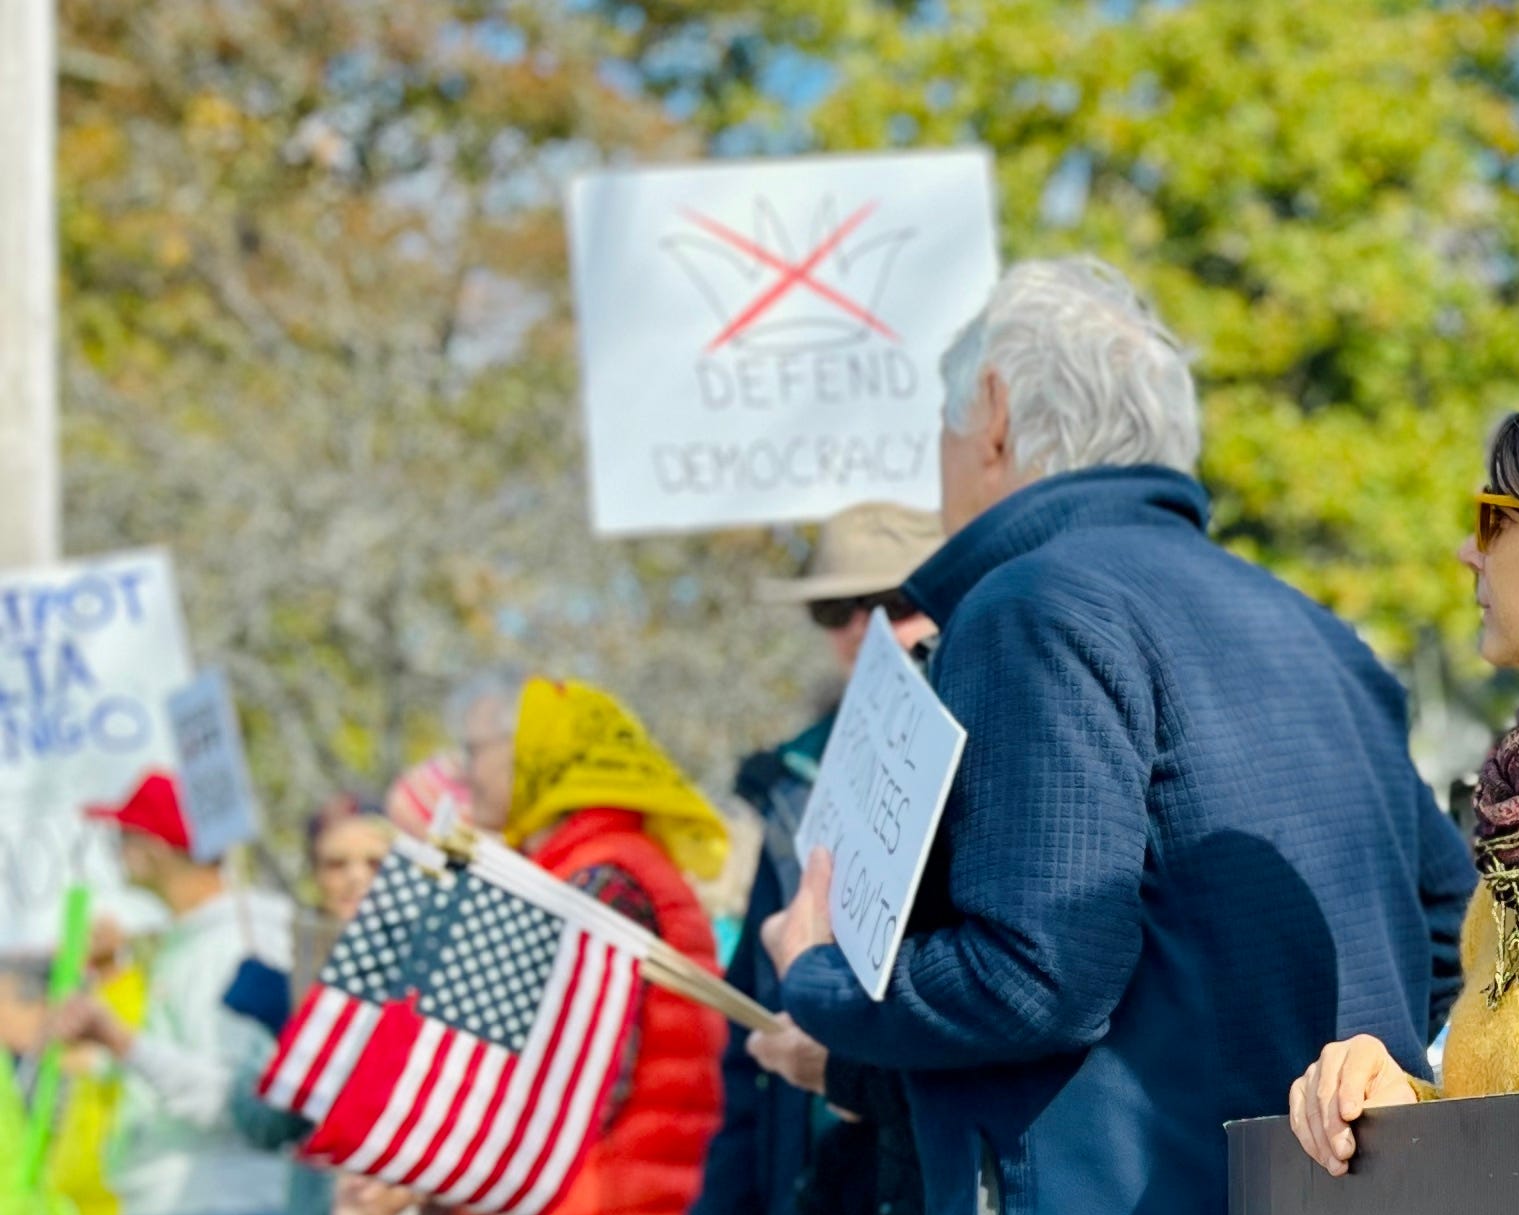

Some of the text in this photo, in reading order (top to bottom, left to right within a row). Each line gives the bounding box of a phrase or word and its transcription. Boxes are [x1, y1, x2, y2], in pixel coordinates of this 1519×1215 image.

[697, 348, 919, 411] DEFEND
[652, 429, 931, 494] DEMOCRACY
[841, 850, 897, 971] GOV'TS
